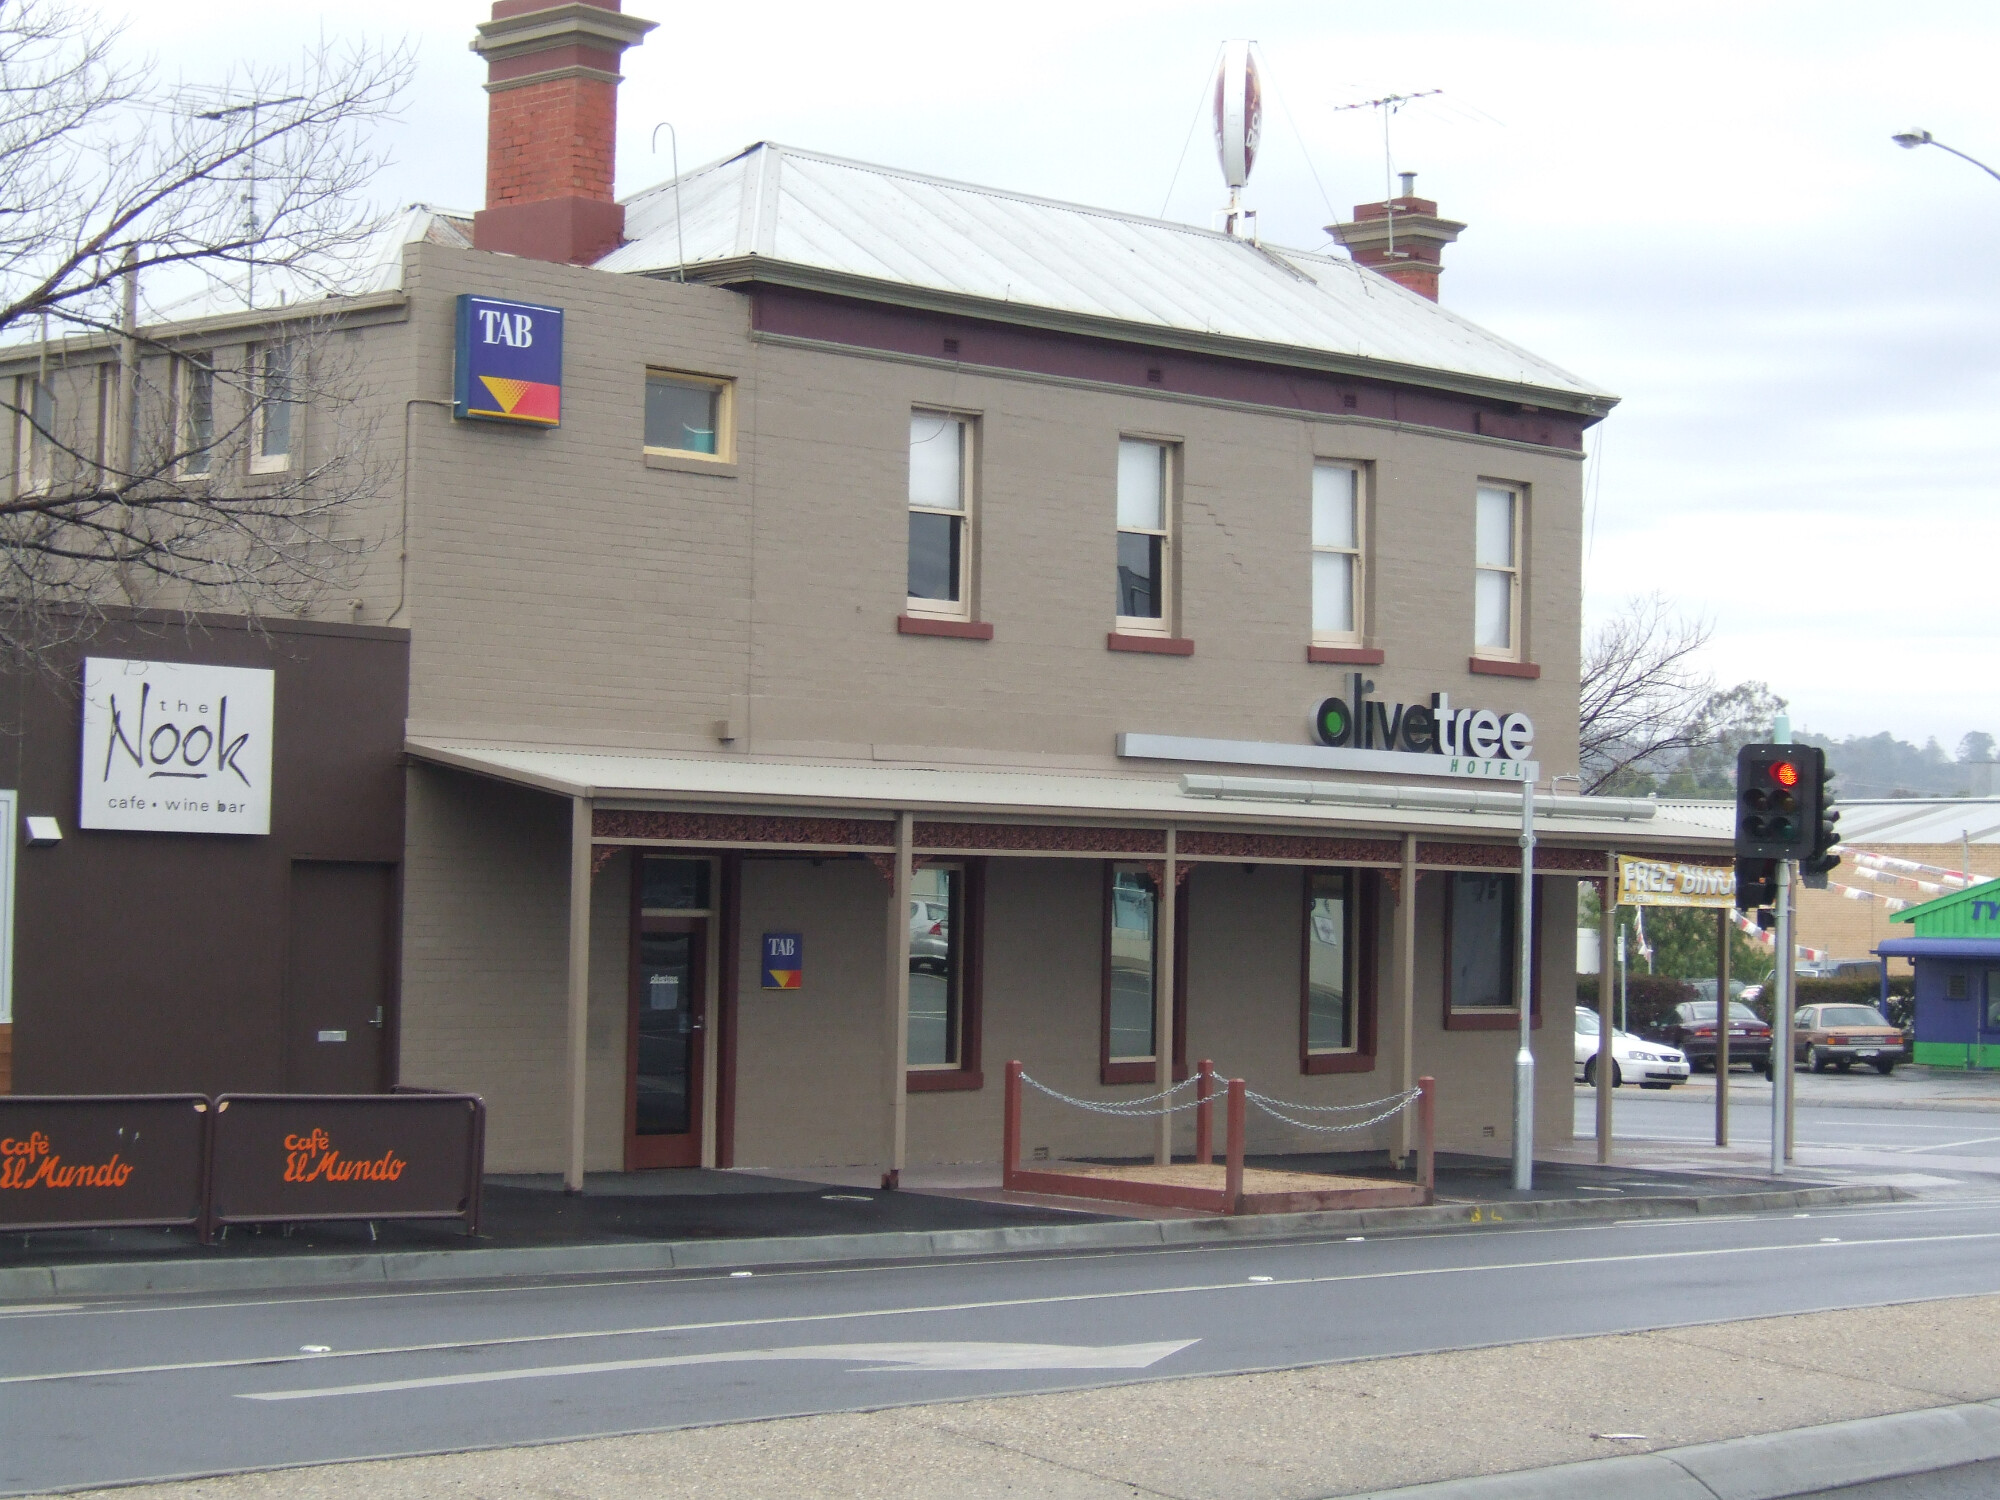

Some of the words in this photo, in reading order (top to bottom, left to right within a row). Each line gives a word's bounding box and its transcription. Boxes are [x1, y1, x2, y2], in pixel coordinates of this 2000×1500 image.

[479, 309, 533, 348] TAB
[160, 700, 209, 714] the
[103, 682, 252, 789] Nook
[1450, 758, 1521, 778] HOTEL
[108, 796, 146, 810] cafe
[165, 798, 210, 812] wine
[217, 800, 246, 814] bar
[1623, 862, 1677, 893] FREE
[1677, 865, 1737, 896] BING
[768, 938, 795, 956] TAB
[0, 1156, 27, 1189] El
[23, 1154, 134, 1190] Mundo
[283, 1151, 309, 1182] El
[305, 1150, 407, 1182] Mundo
